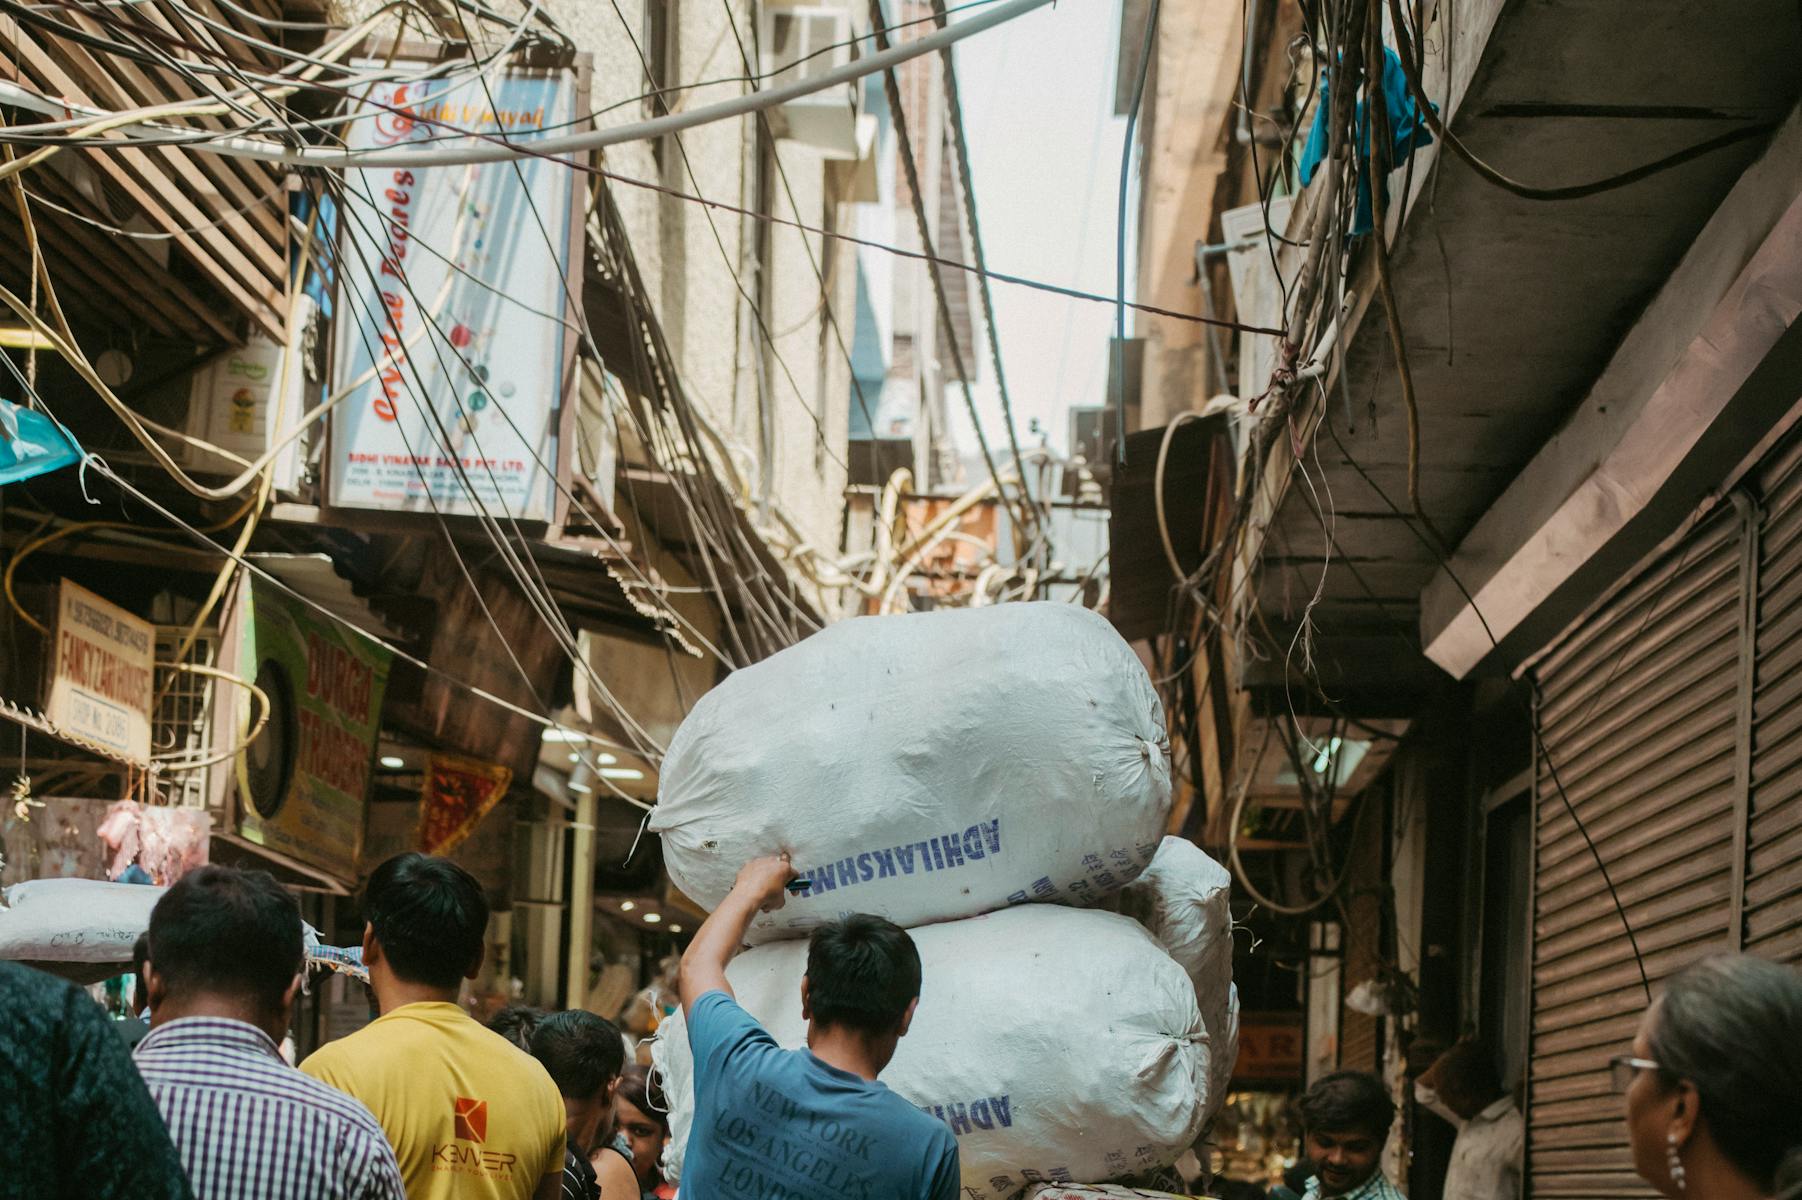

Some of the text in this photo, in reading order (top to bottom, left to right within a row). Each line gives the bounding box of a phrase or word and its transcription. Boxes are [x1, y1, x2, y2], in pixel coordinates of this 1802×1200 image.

[714, 1108, 760, 1148] LOS
[747, 1080, 801, 1123] NEW
[806, 1111, 878, 1161] YORK
